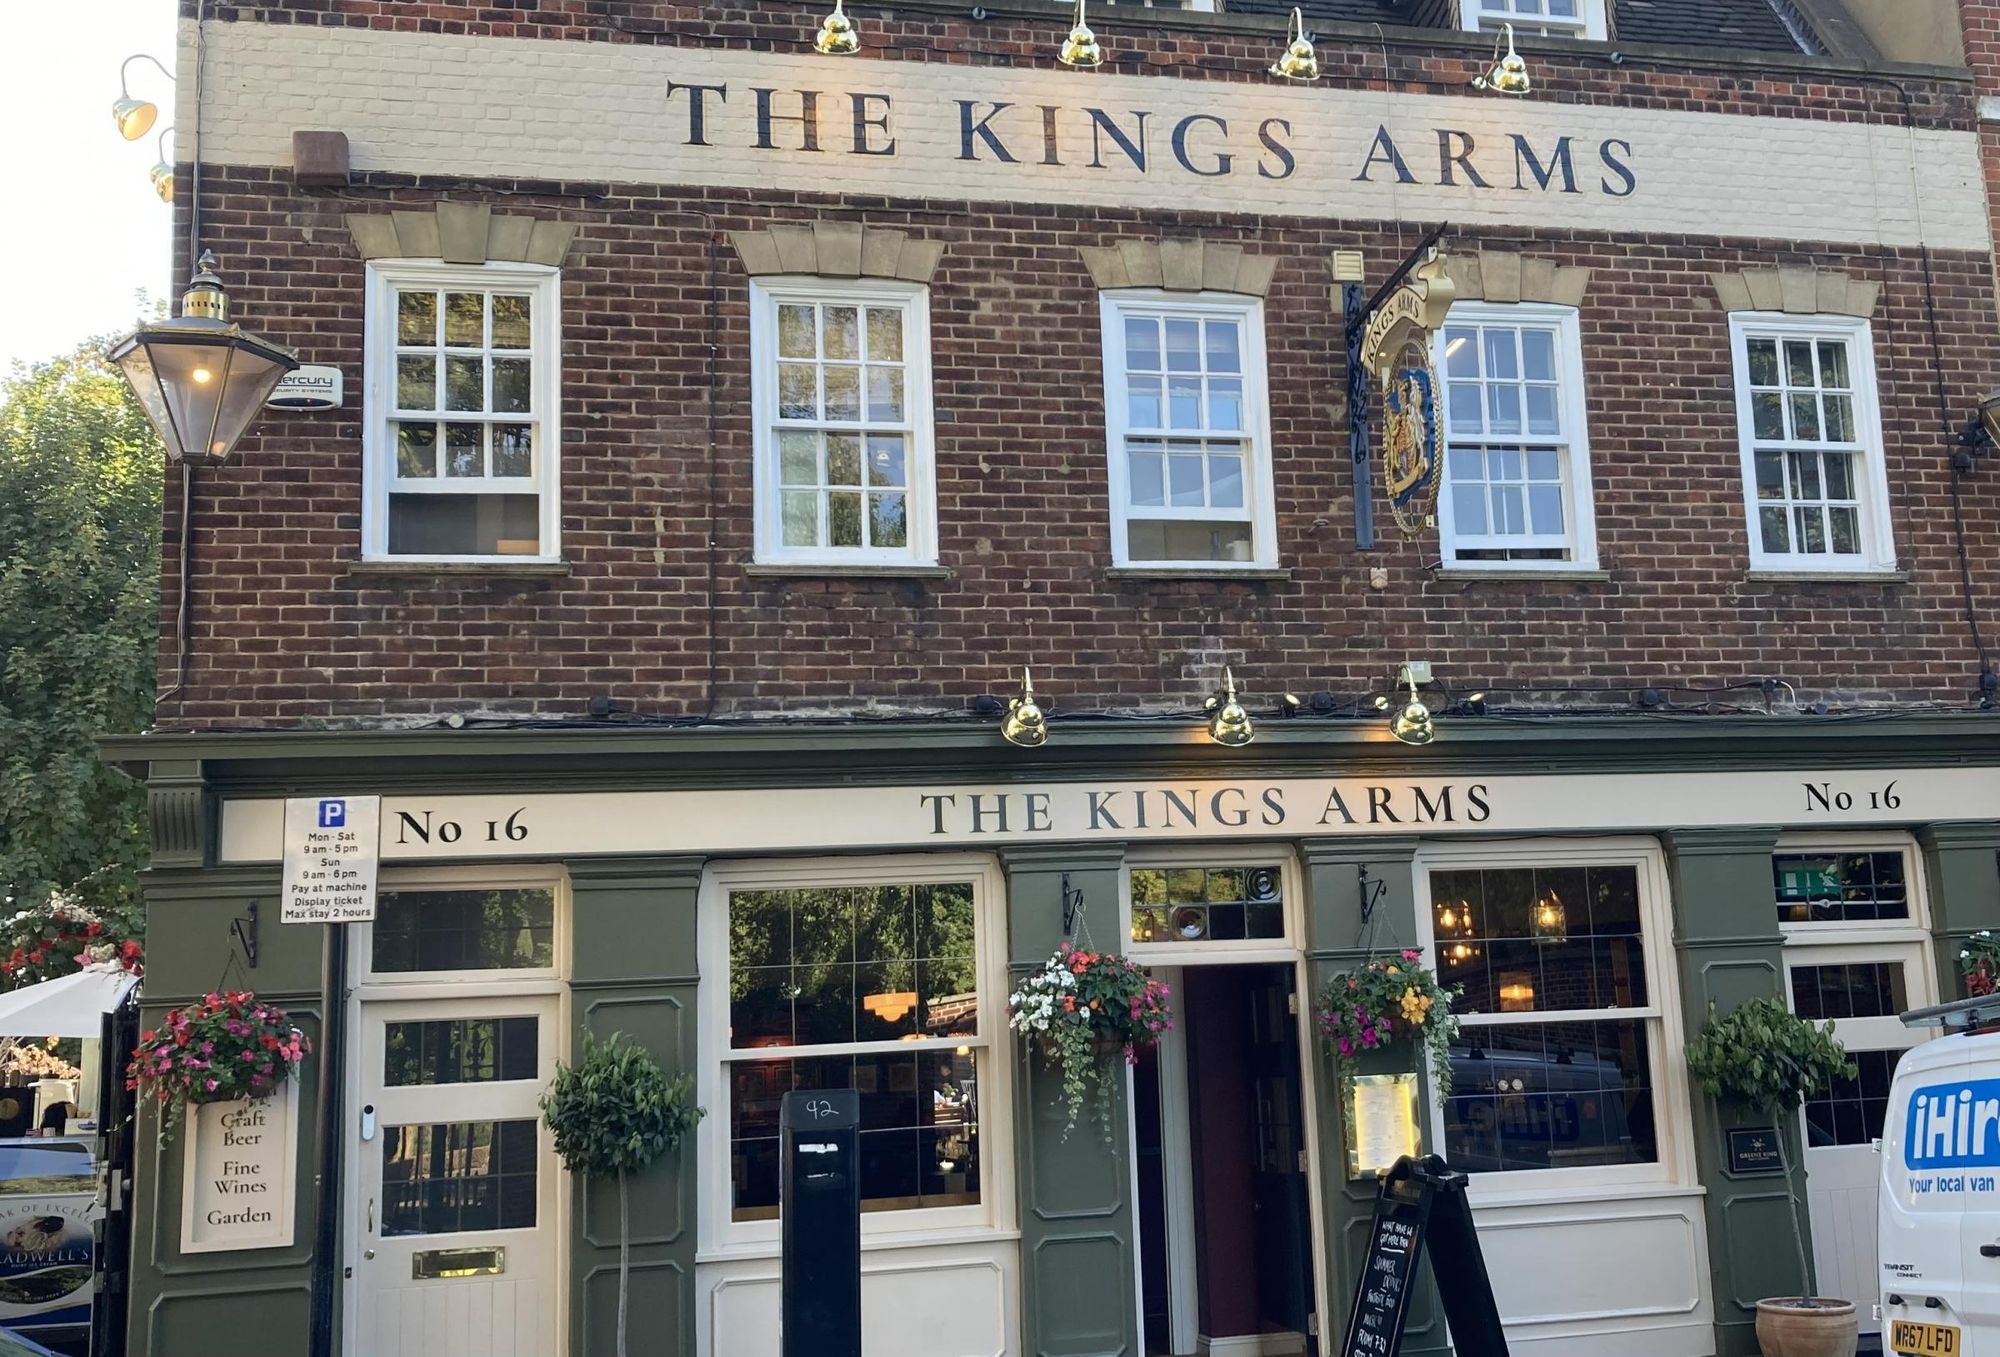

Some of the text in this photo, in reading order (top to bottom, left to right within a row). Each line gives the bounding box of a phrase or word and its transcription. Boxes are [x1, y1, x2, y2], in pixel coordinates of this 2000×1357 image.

[666, 79, 1637, 197] THE KINGS ARMS
[1367, 294, 1419, 364] KINGS ARMS
[279, 376, 333, 388] ercury
[1802, 780, 1901, 812] No 16
[325, 803, 342, 825] P
[920, 784, 1491, 834] THE KINGS ARMS
[394, 806, 529, 844] No 16
[308, 833, 329, 842] Mon
[337, 832, 355, 841] Sat
[320, 858, 340, 867] Sun
[291, 883, 367, 894] Pay at machine
[294, 896, 363, 907] Display ticket
[285, 908, 371, 919] Max stay 2 hours
[220, 1110, 266, 1129] Craft
[1913, 1089, 2000, 1159] iHir
[223, 1132, 262, 1147] Beer
[223, 1161, 260, 1176] Fine
[215, 1180, 267, 1194] Wines
[1909, 1176, 1995, 1193] Your local van
[207, 1207, 271, 1226] Garden
[0, 1249, 89, 1264] ADWELL'S
[1927, 1327, 1953, 1352] LFD
